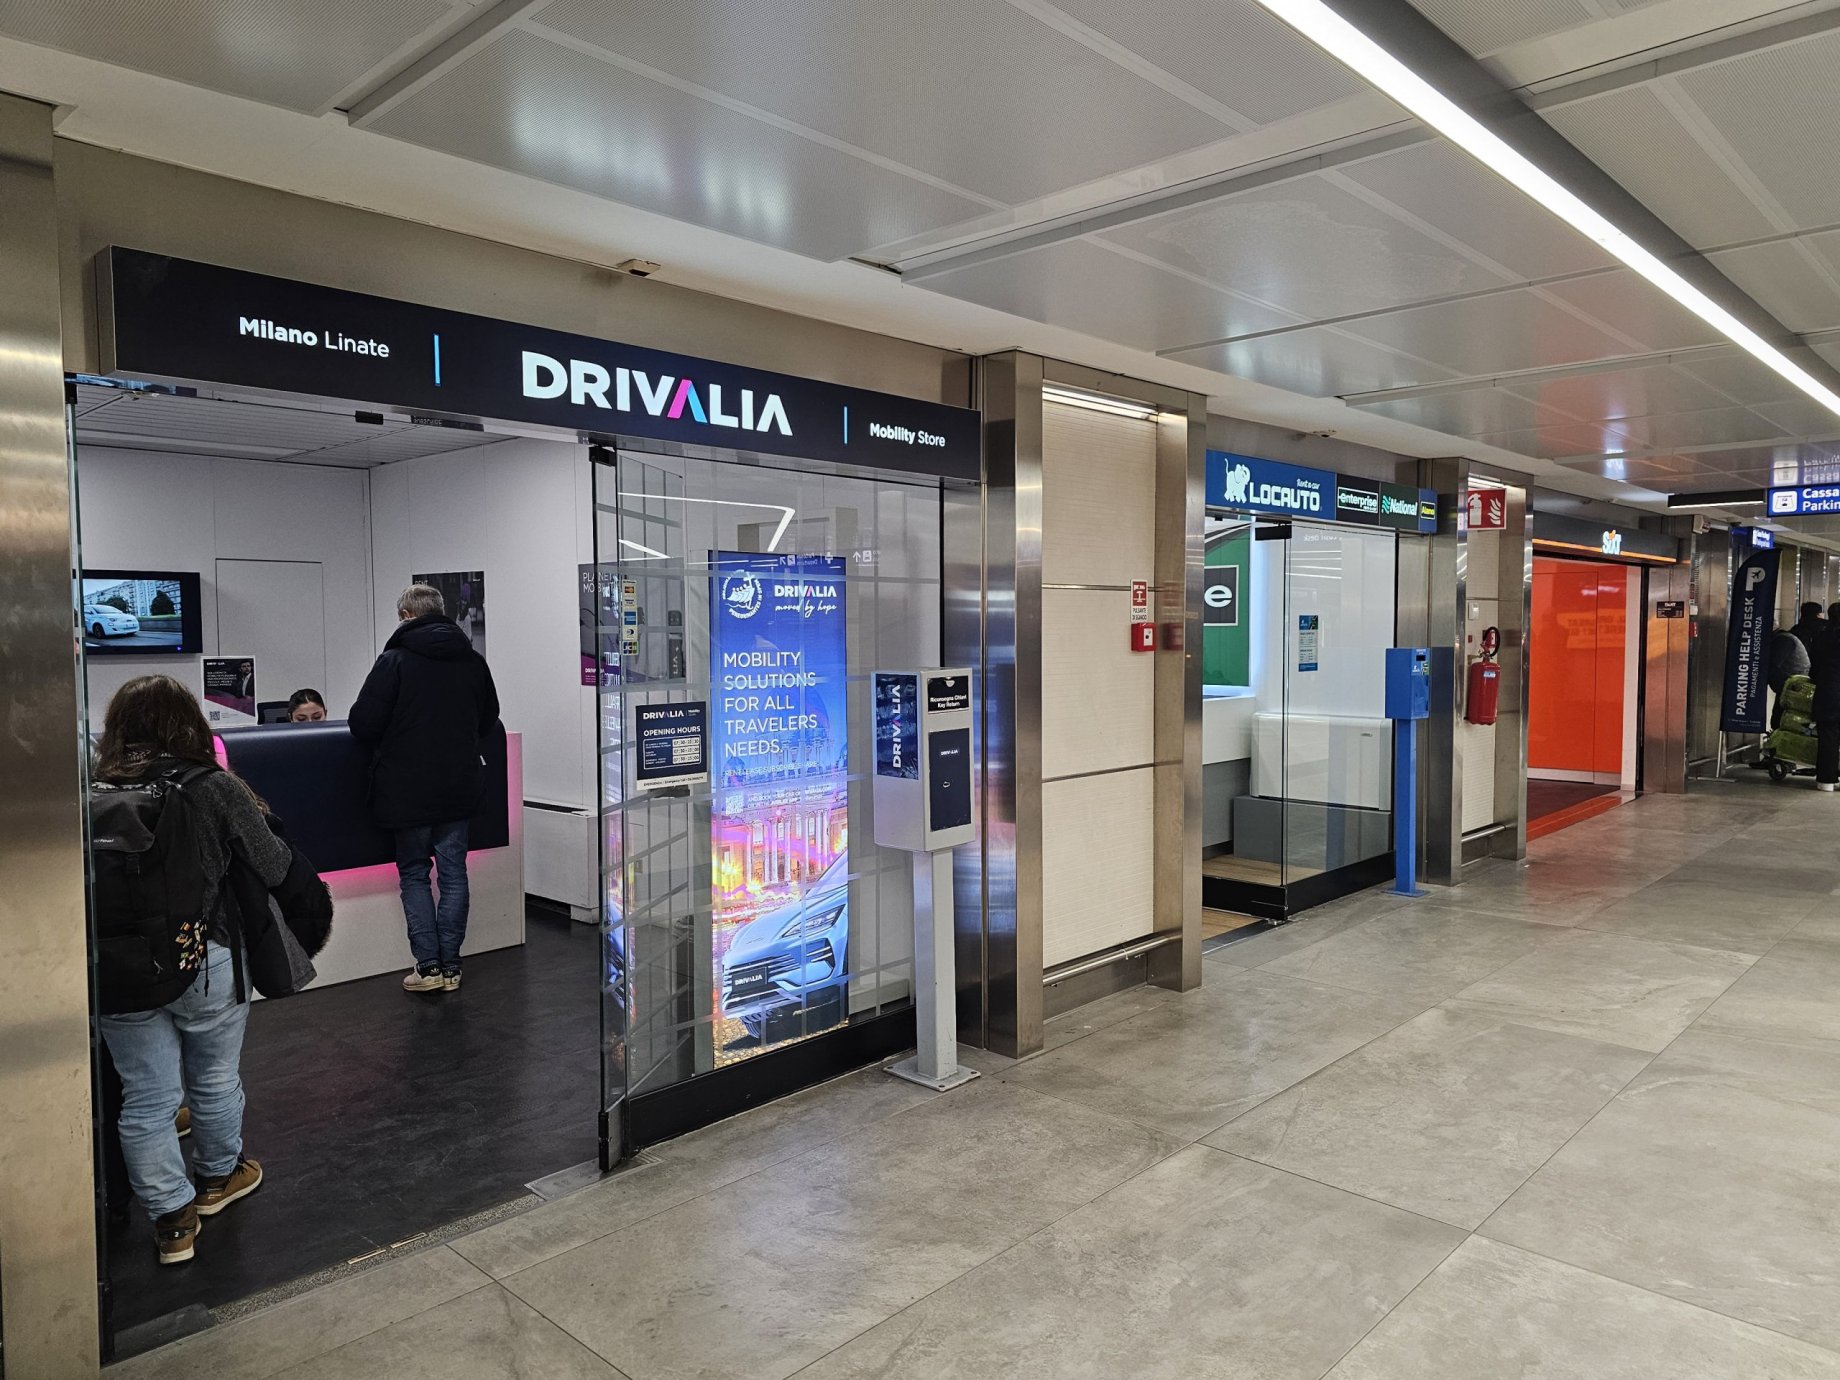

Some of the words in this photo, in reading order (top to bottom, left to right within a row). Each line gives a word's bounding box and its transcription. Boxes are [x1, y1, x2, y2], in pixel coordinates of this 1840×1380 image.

[239, 316, 318, 346] Milano
[324, 330, 390, 358] Linate
[521, 350, 793, 436] DRIVALIA
[869, 422, 915, 445] Mobility
[917, 431, 946, 447] Store
[1249, 481, 1320, 512] LOCAUTO
[1338, 491, 1378, 509] enterprise
[1802, 488, 1840, 499] Cassa
[1390, 498, 1418, 516] National
[774, 585, 837, 598] DRIVALIA
[1204, 584, 1233, 608] e
[775, 599, 804, 613] moved
[805, 600, 815, 618] by
[817, 600, 837, 614] hope
[1743, 597, 1755, 629] DESK
[1753, 616, 1763, 655] ASSISTENZA
[1739, 634, 1751, 662] HELP
[723, 651, 801, 668] MOBILITY
[724, 672, 816, 691] SOLUTIONS
[1736, 664, 1749, 716] PARKING
[1750, 661, 1760, 698] PAGAMENTI
[725, 696, 759, 713] FOR
[764, 695, 795, 711] ALL
[642, 710, 685, 720] DRIVALIA
[724, 714, 818, 735] TRAVELERS
[643, 727, 676, 737] OPENING
[677, 725, 701, 734] HOURS
[891, 684, 902, 768] DRIVALIA
[725, 739, 783, 758] NEEDS.
